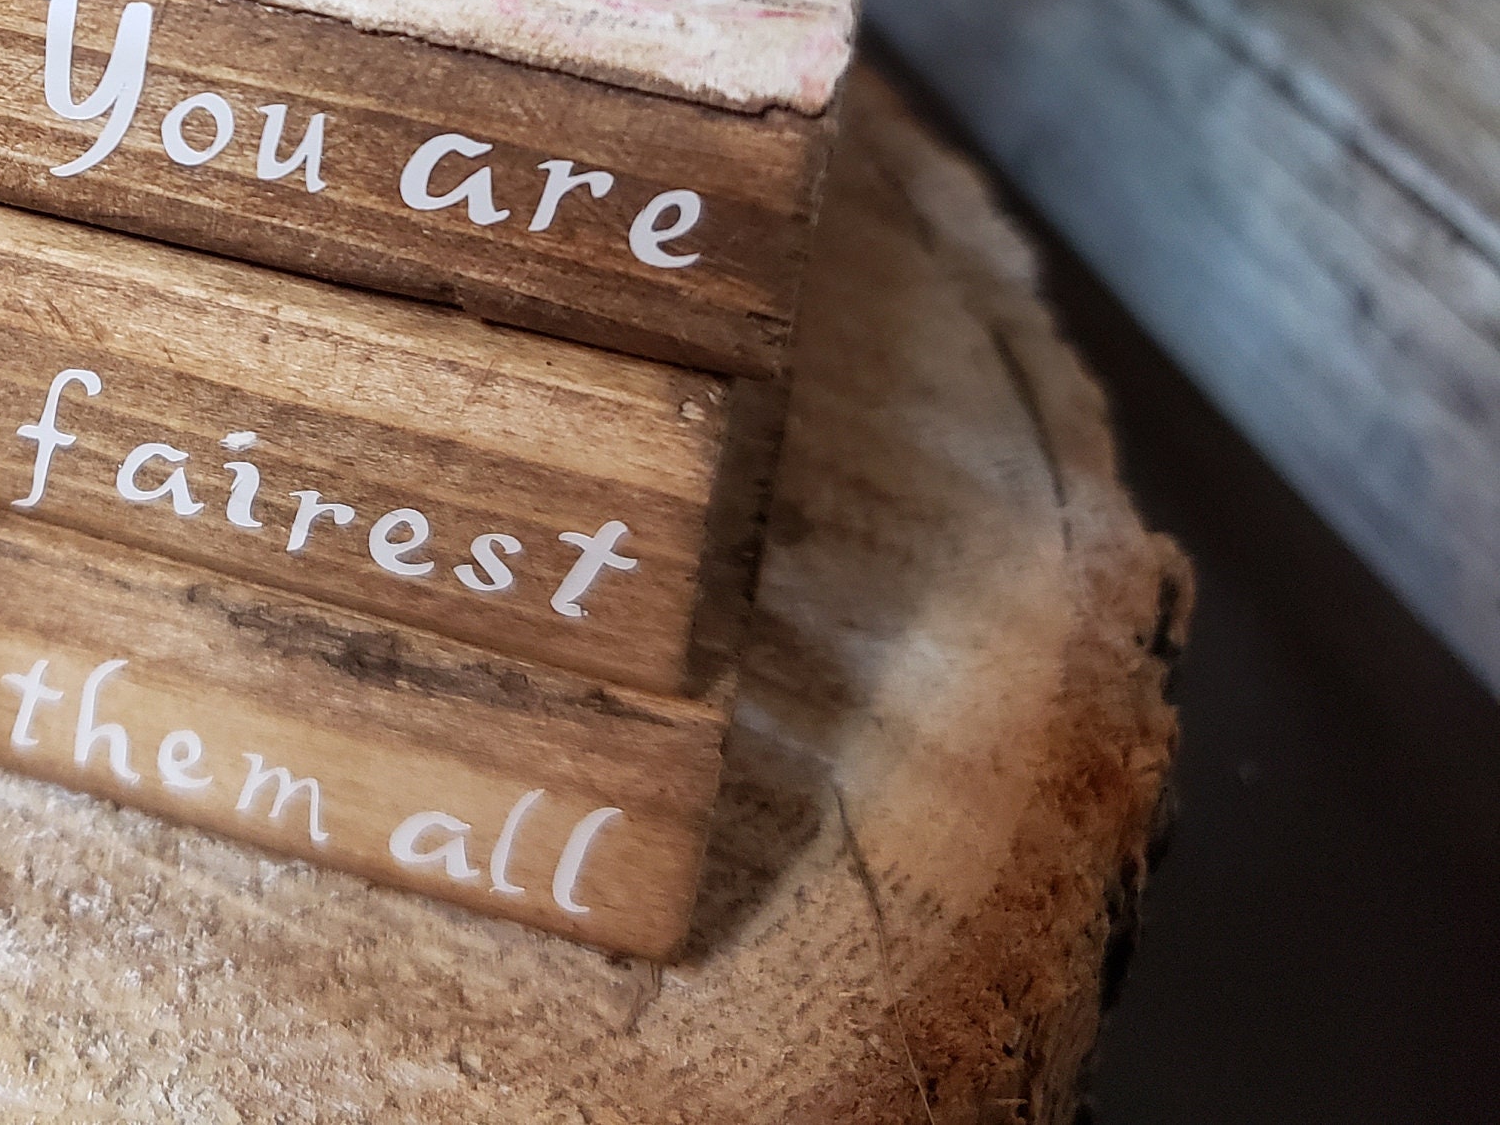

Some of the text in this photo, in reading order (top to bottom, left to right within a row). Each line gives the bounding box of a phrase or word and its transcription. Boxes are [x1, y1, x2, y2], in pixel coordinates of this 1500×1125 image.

[398, 132, 702, 269] are
[11, 368, 638, 618] fairest
[0, 656, 330, 844] them
[388, 788, 622, 914] all
